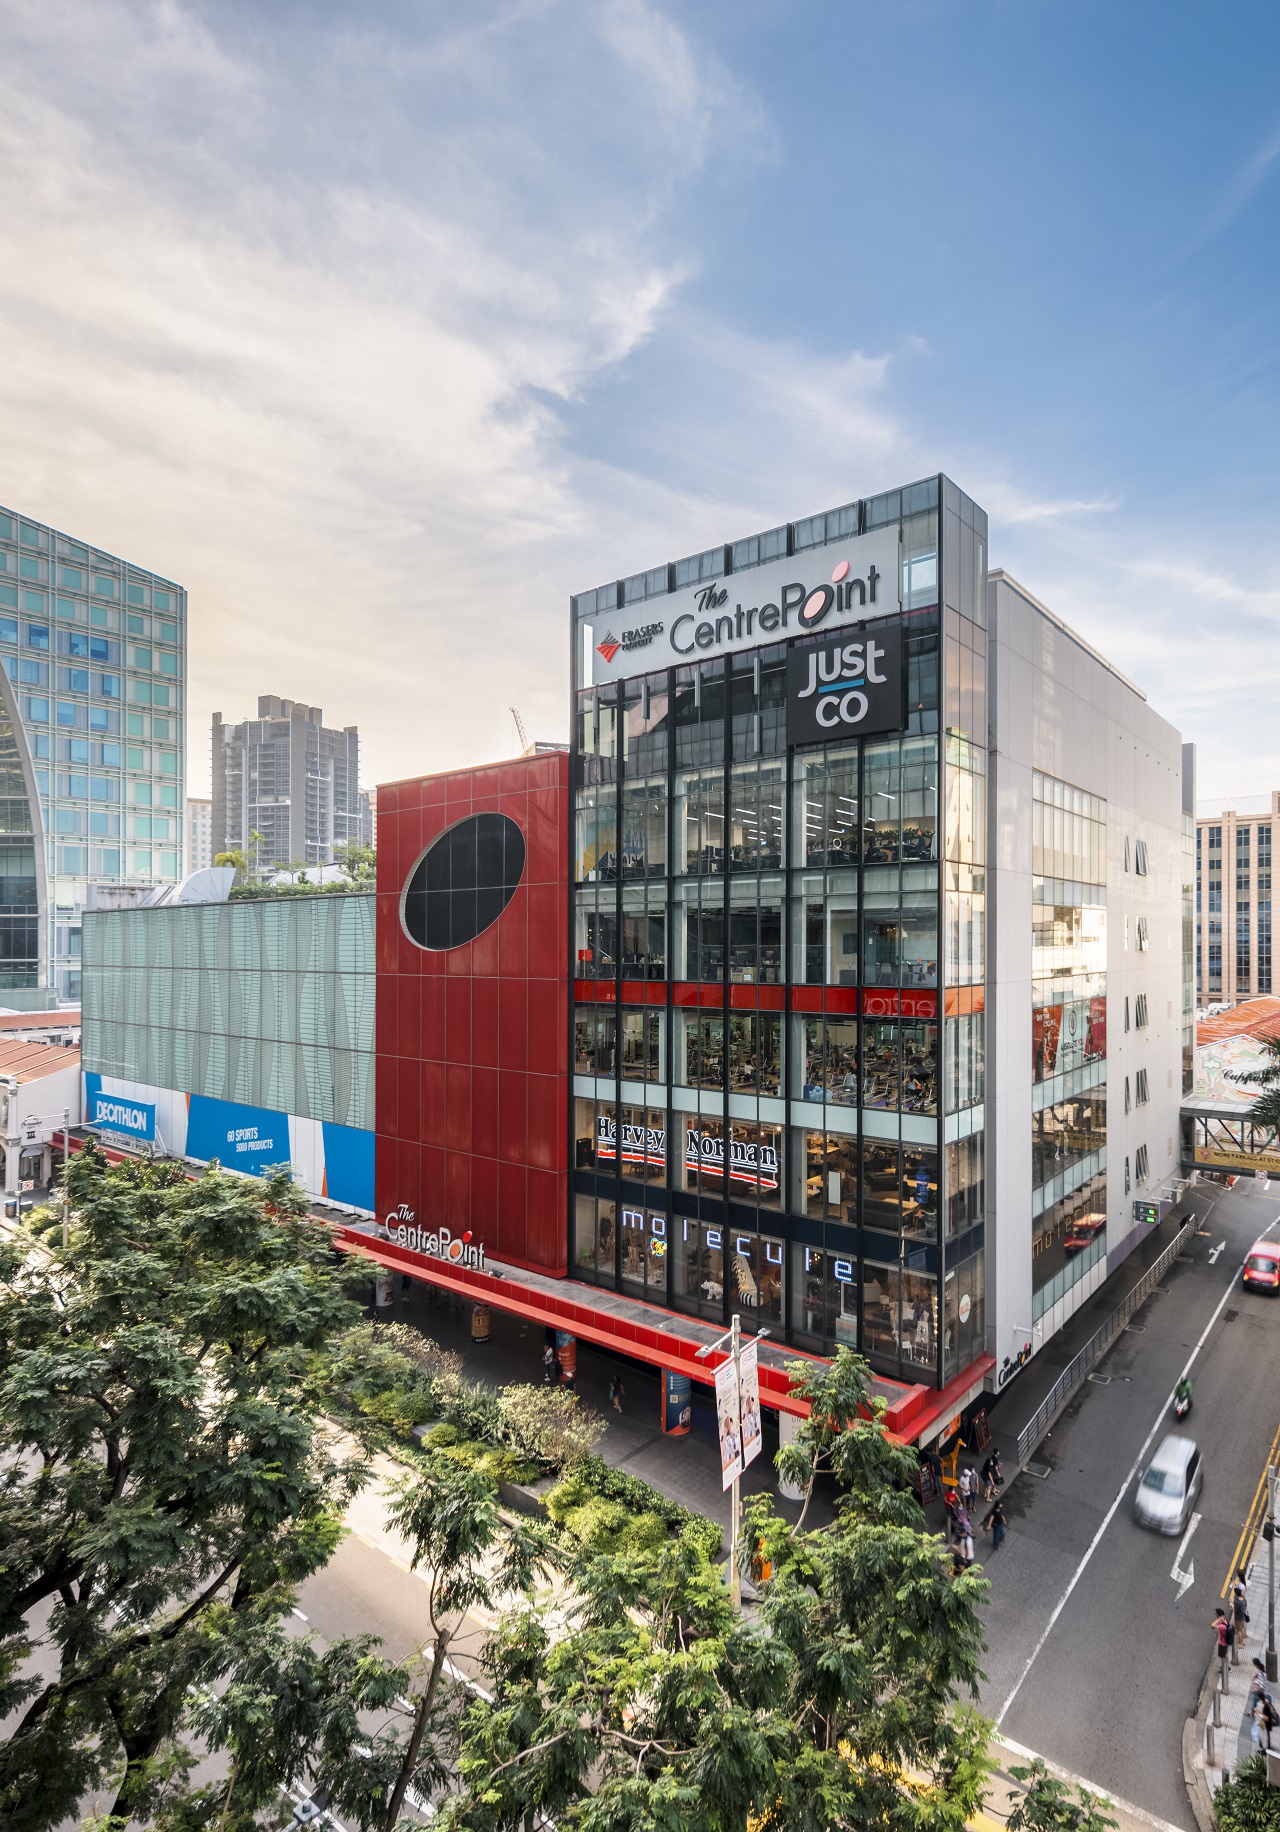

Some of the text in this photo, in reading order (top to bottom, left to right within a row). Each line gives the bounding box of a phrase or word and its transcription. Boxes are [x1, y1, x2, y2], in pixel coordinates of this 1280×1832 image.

[670, 560, 880, 654] CentrePoint
[694, 582, 728, 612] The
[622, 622, 664, 643] FRASERS
[96, 1100, 147, 1132] DECATHLON
[227, 1127, 258, 1142] 60 SPORTS
[247, 1139, 273, 1151] PRODUCTS
[597, 1117, 777, 1167] Harvey Norman
[1214, 1151, 1230, 1159] MORE
[1231, 1152, 1258, 1162] PARKING
[398, 1204, 415, 1221] The
[386, 1212, 485, 1270] CentrePoint
[622, 1210, 852, 1282] molecule
